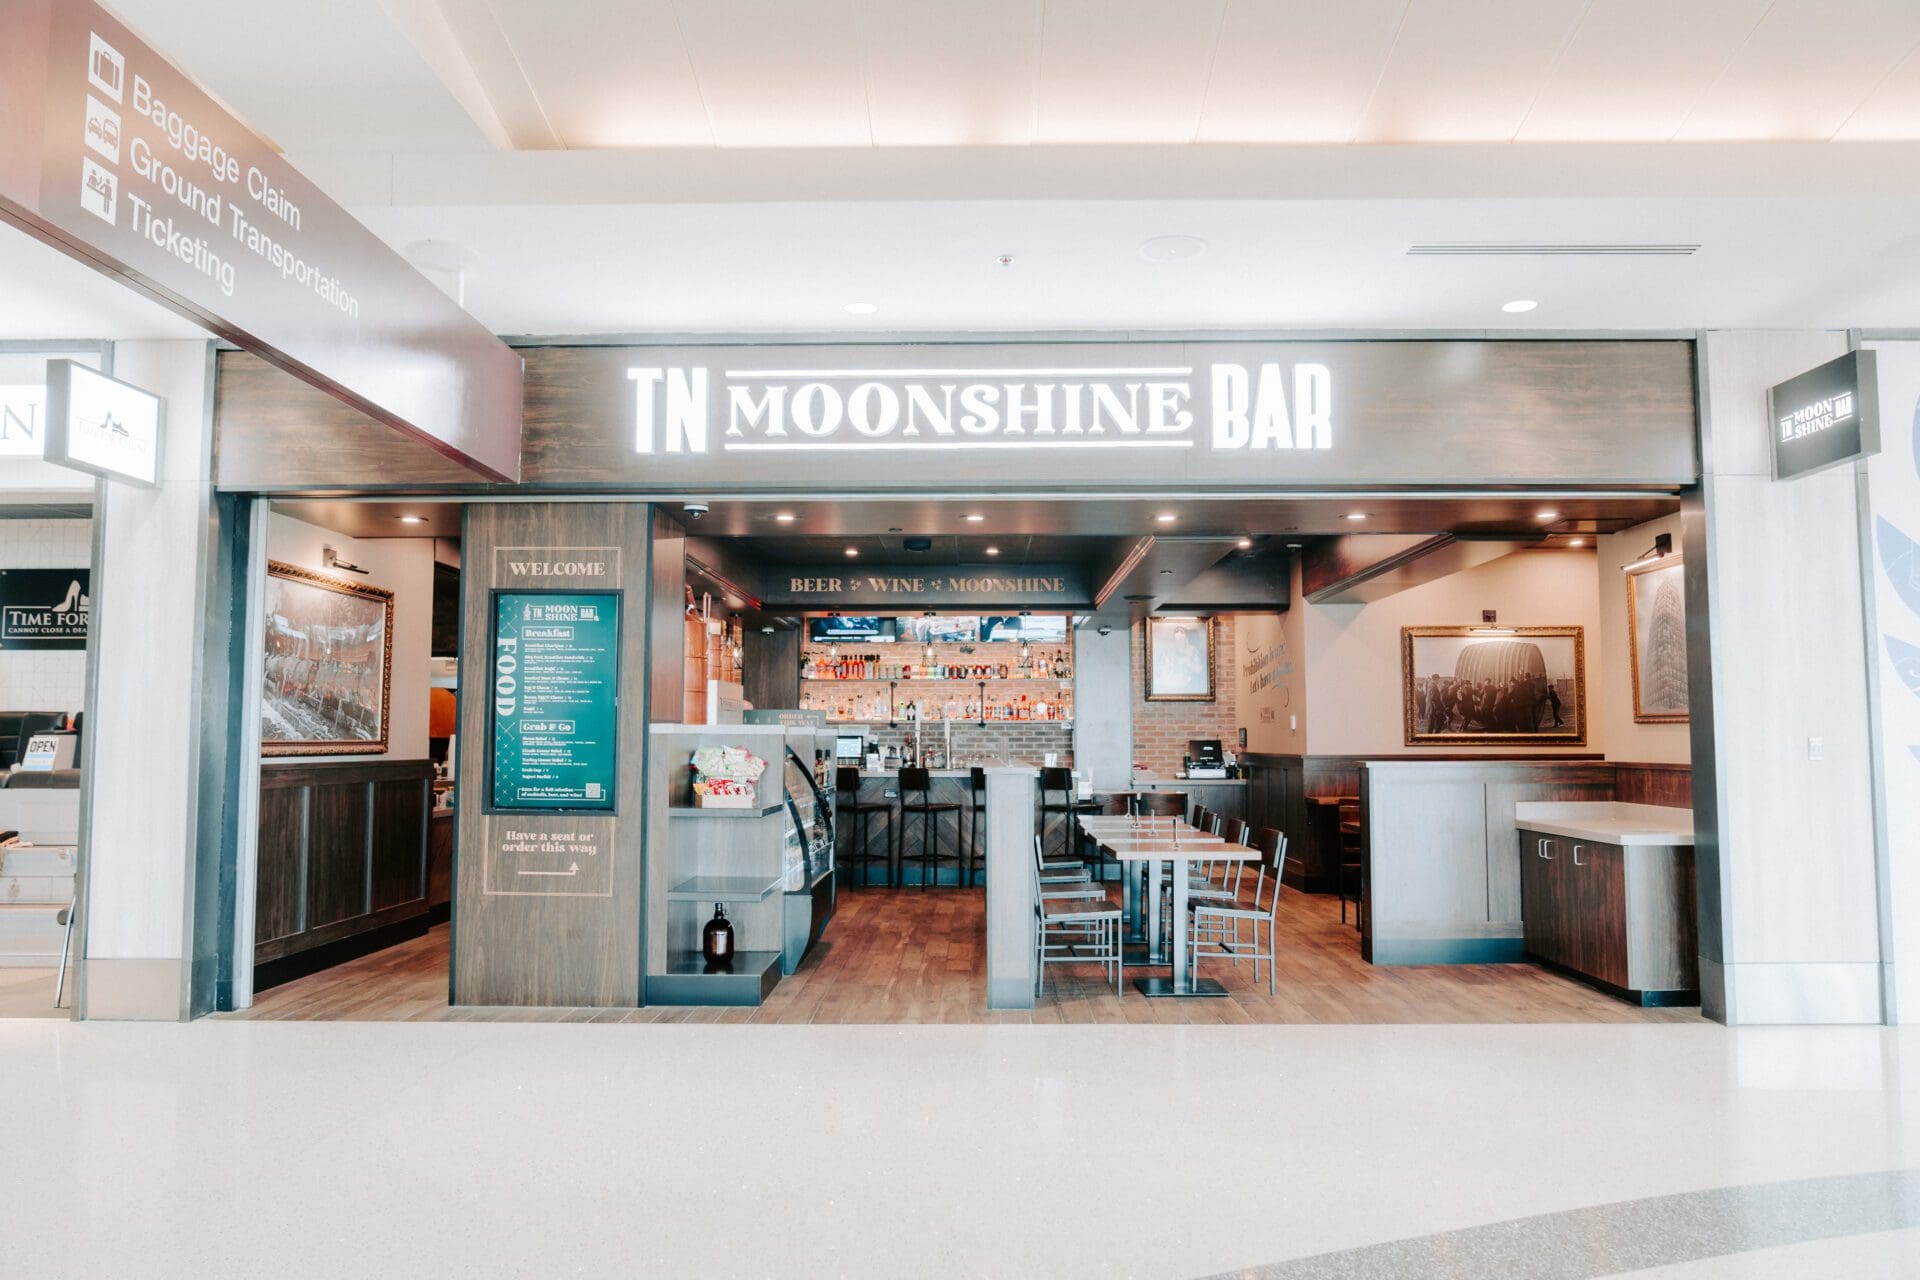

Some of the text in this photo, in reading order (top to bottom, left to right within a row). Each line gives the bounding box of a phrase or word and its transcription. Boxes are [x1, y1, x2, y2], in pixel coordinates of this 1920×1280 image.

[132, 74, 301, 231] Baggage Claim
[130, 136, 359, 319] Ground Transportation
[129, 194, 236, 297] Ticketing
[627, 363, 1333, 454] TN MOONSHINE BAR
[1793, 398, 1834, 425] MOON
[1795, 413, 1834, 438] SHINE
[1835, 396, 1852, 418] BAR
[508, 562, 606, 576] WELCOME
[790, 577, 1066, 592] BEER WINE MOONSHINE
[545, 605, 578, 613] MOON
[9, 611, 88, 626] TIME FOR
[545, 613, 578, 621] SHINE
[525, 628, 570, 638] Breakfast
[496, 637, 517, 716] FOOD
[523, 722, 547, 731] Grab
[558, 723, 571, 731] Go
[29, 740, 57, 752] OPEN
[506, 831, 537, 840] Have
[540, 832, 548, 840] a
[551, 832, 575, 841] seat
[502, 842, 597, 855] order this way
